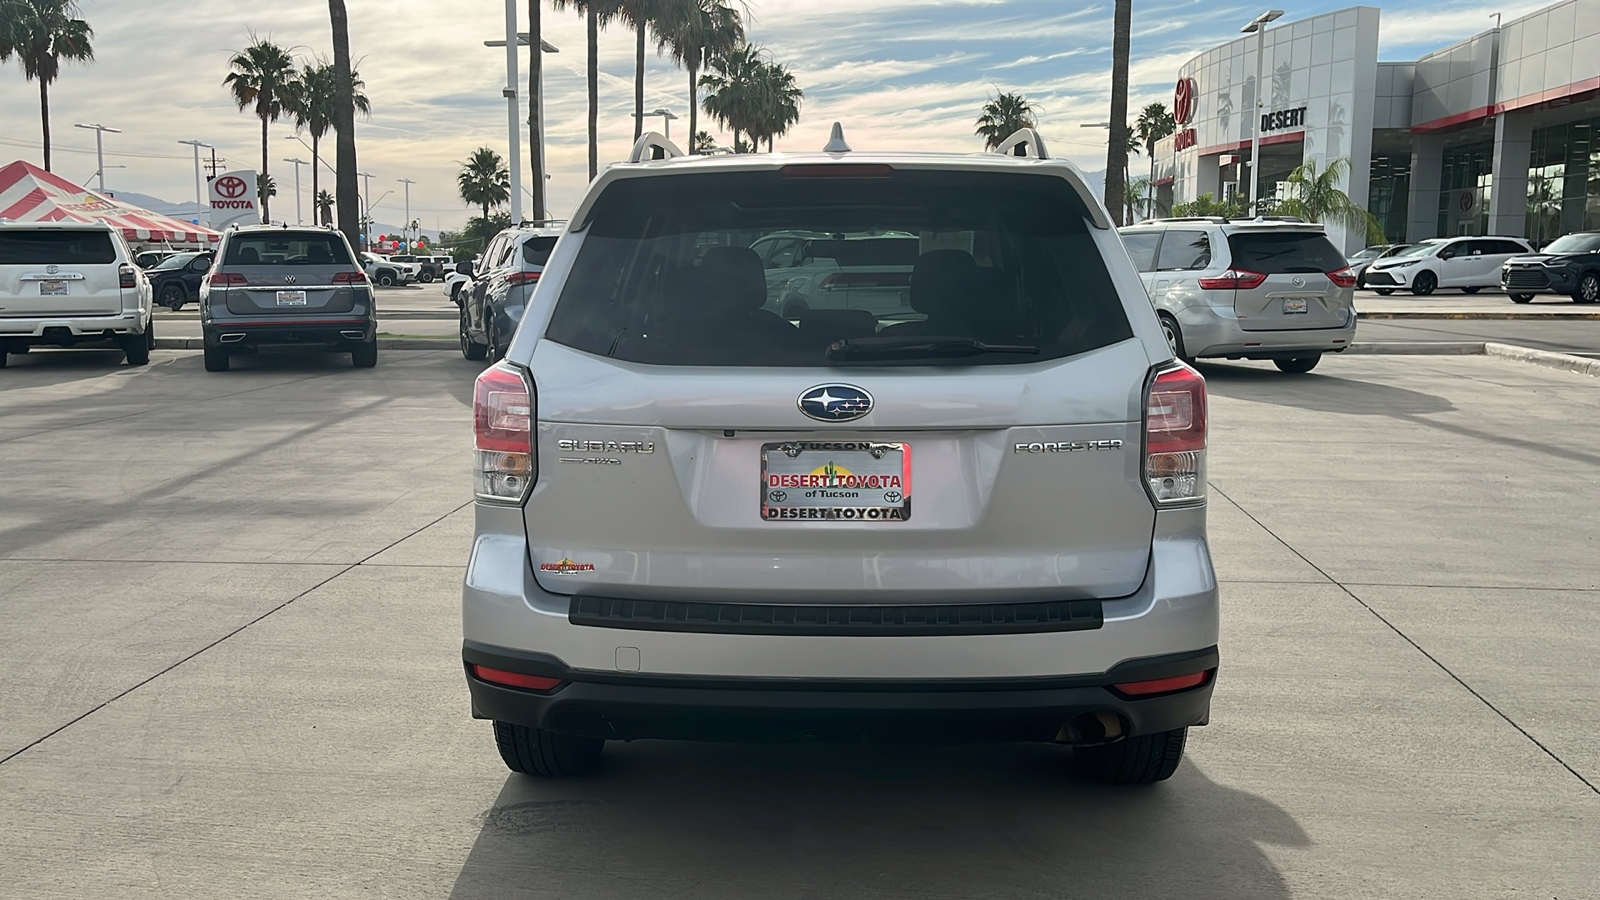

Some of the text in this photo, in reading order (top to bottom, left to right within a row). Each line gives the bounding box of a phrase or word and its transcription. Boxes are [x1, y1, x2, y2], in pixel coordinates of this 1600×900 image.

[1260, 107, 1307, 132] DESERT
[210, 200, 254, 209] TOYOTA
[558, 439, 654, 453] SUBARU
[798, 442, 870, 450] TUCSON
[1014, 438, 1123, 453] FORESTER
[581, 457, 622, 465] AWD
[769, 474, 902, 488] DESERT TOYOTA
[805, 490, 859, 498] of Tucson
[767, 507, 902, 519] DESERT TOYOTA
[568, 563, 595, 571] TOYOTA
